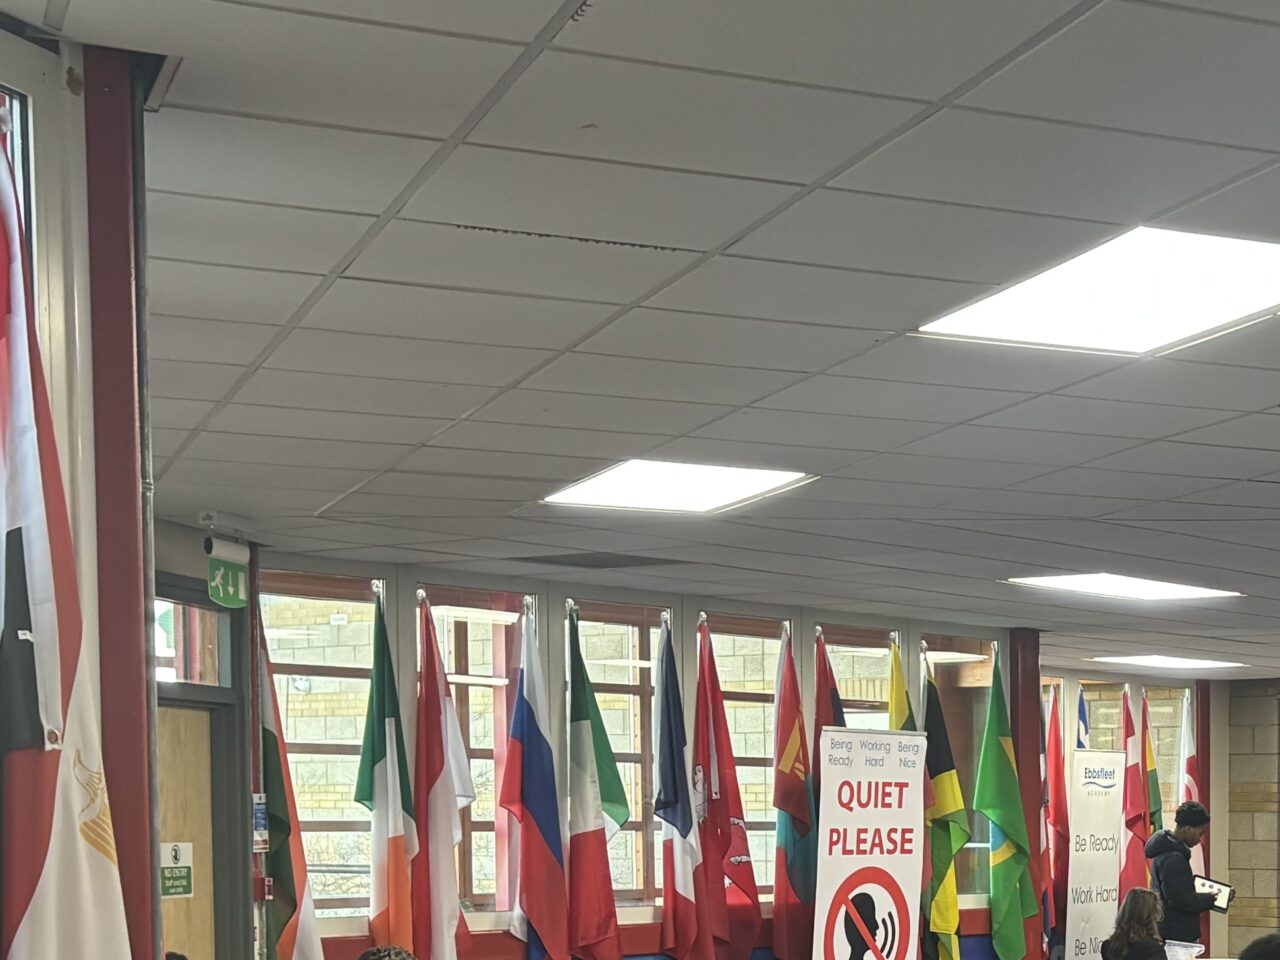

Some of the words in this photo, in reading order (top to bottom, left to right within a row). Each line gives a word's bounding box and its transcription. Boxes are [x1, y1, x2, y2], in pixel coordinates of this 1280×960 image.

[830, 738, 853, 753] Being
[860, 740, 891, 754] Working
[898, 741, 919, 756] Being
[828, 754, 854, 768] Ready
[865, 756, 885, 767] Hard
[899, 757, 917, 769] Nice
[1084, 767, 1116, 780] Ebbsfleet
[837, 780, 910, 813] QUIET
[827, 827, 914, 856] PLEASE
[1075, 834, 1087, 853] Be
[1089, 833, 1120, 855] Ready
[1071, 886, 1093, 904] Work
[1095, 885, 1117, 902] Hard
[1074, 938, 1087, 956] Be
[1089, 936, 1104, 955] Nic
